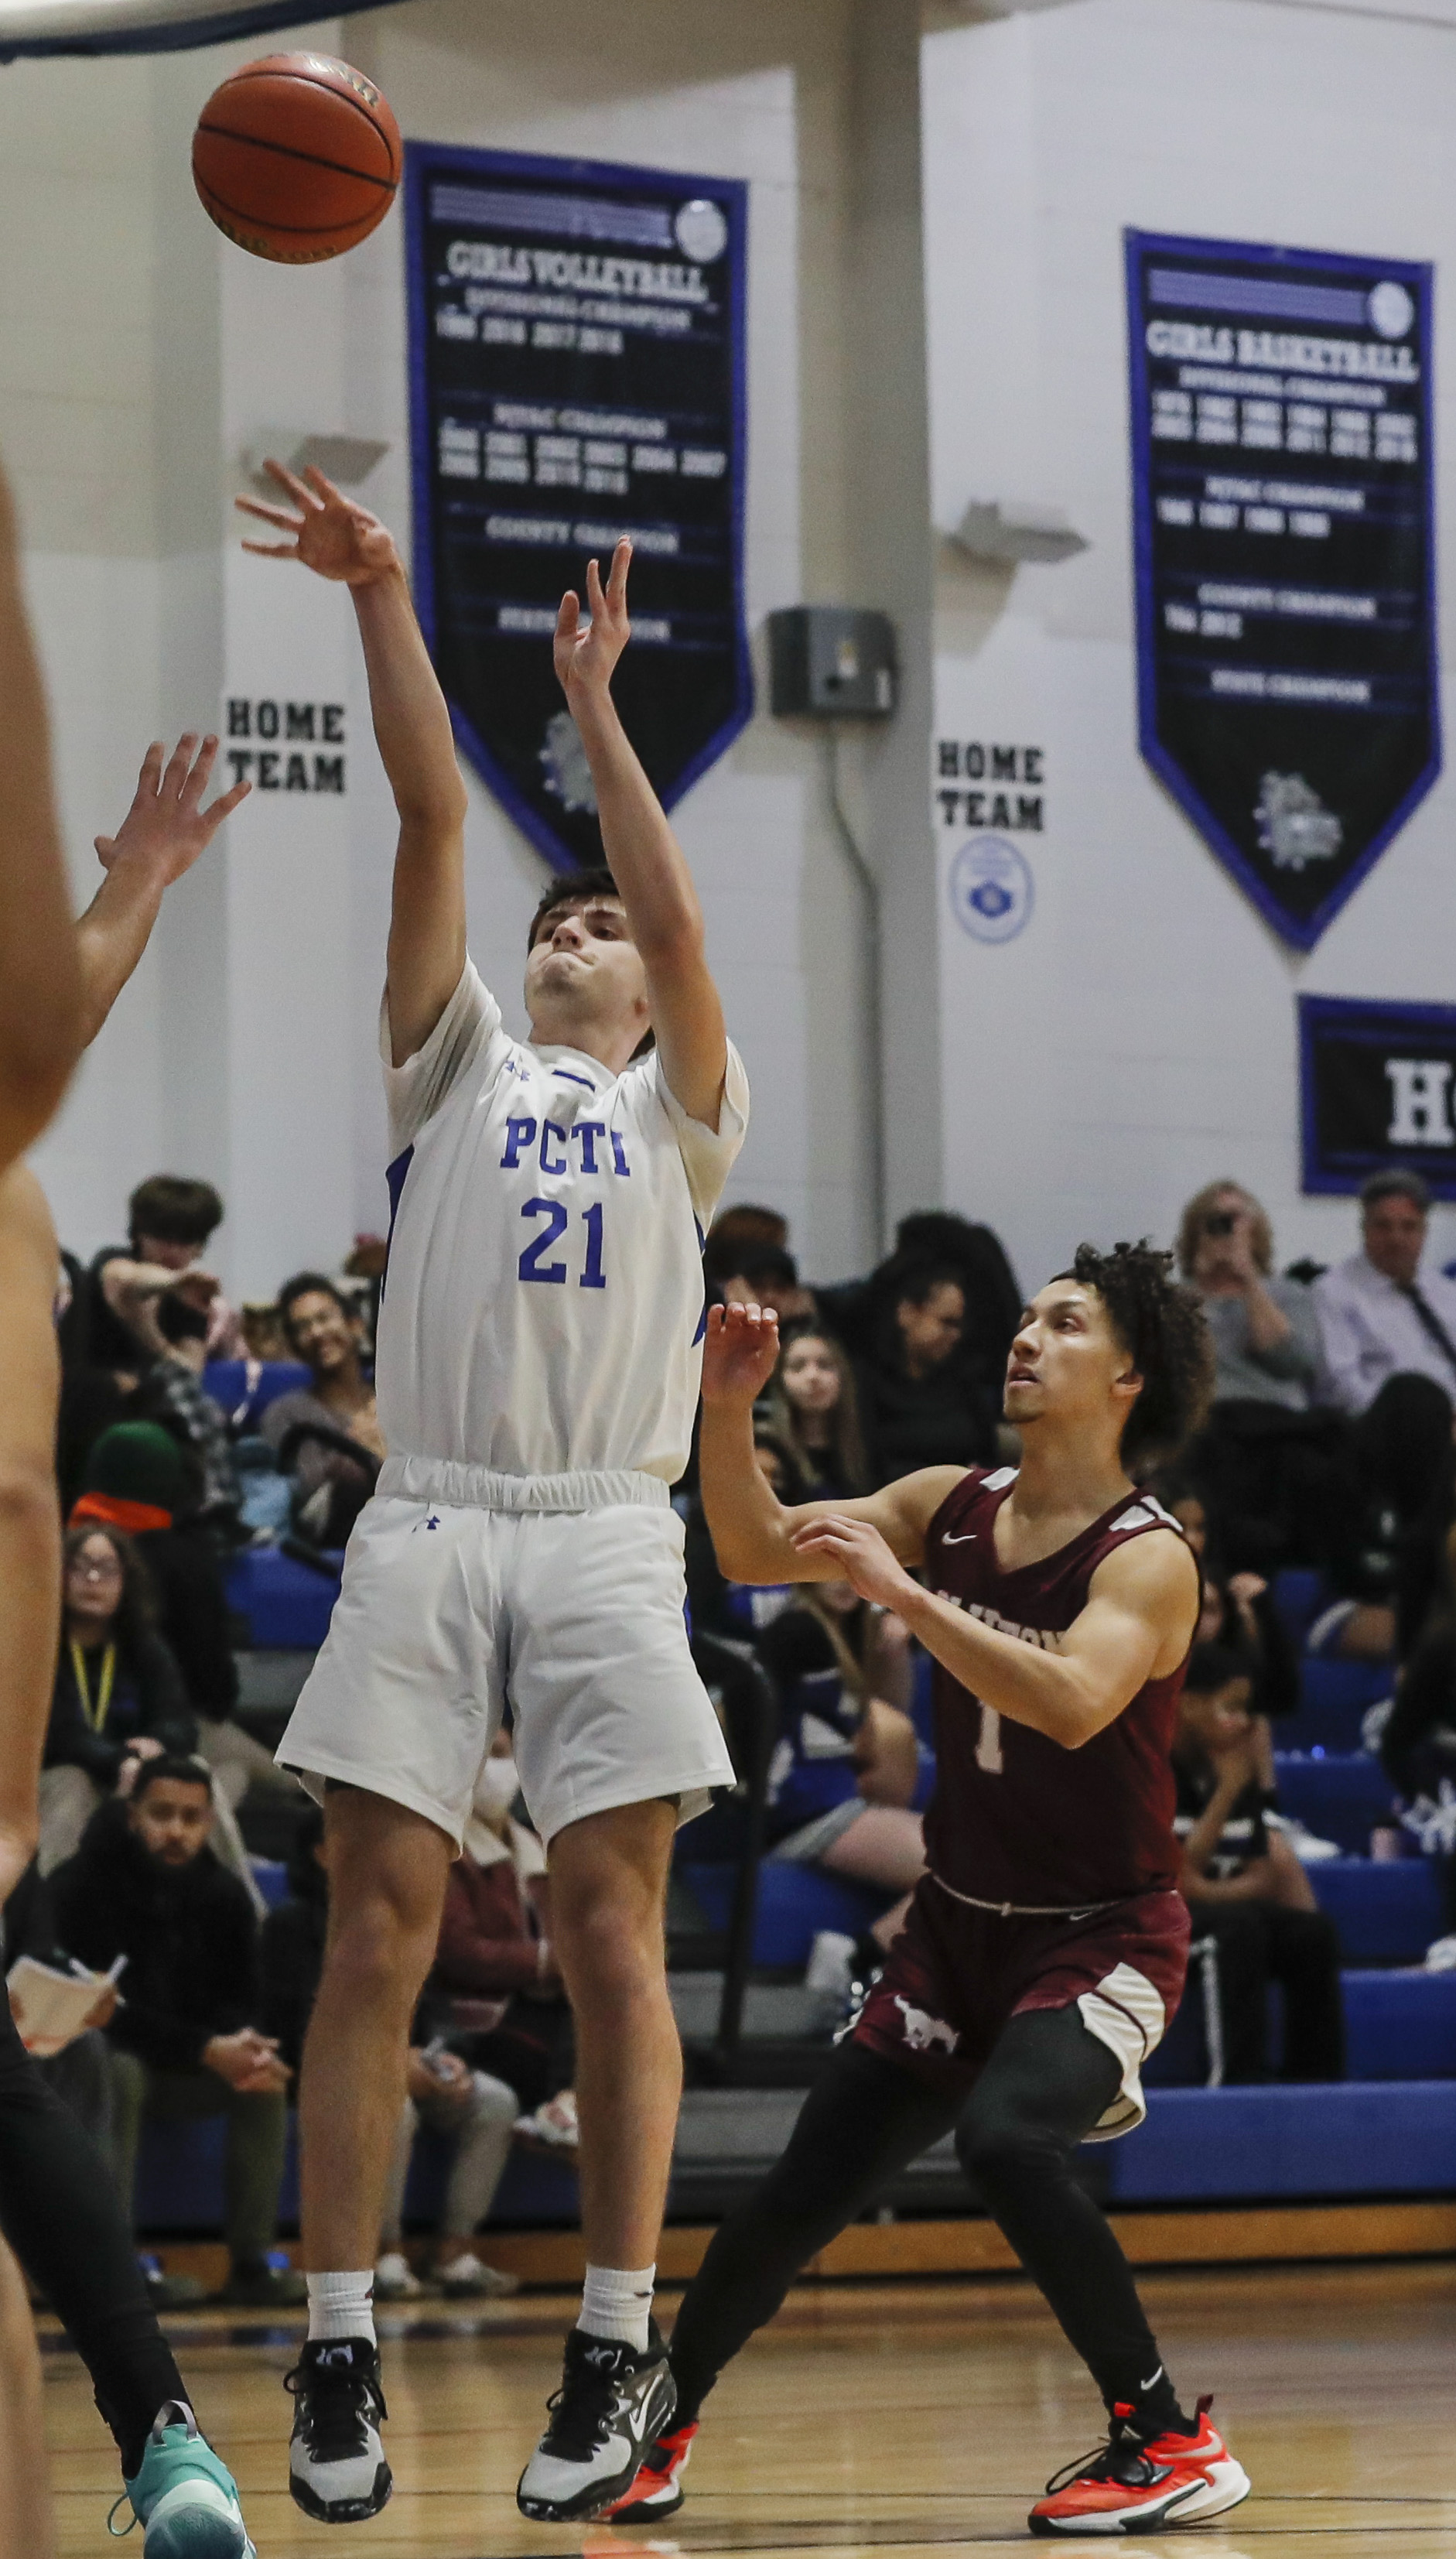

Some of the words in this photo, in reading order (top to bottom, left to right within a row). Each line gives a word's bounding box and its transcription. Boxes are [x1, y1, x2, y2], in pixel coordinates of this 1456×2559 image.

[227, 698, 345, 743] HOME
[227, 749, 345, 793] TEAM
[938, 741, 1043, 784] HOME
[938, 789, 1043, 833] TEAM
[1385, 1057, 1456, 1148] H
[500, 1117, 630, 1177] PCTI
[518, 1197, 606, 1288] 21
